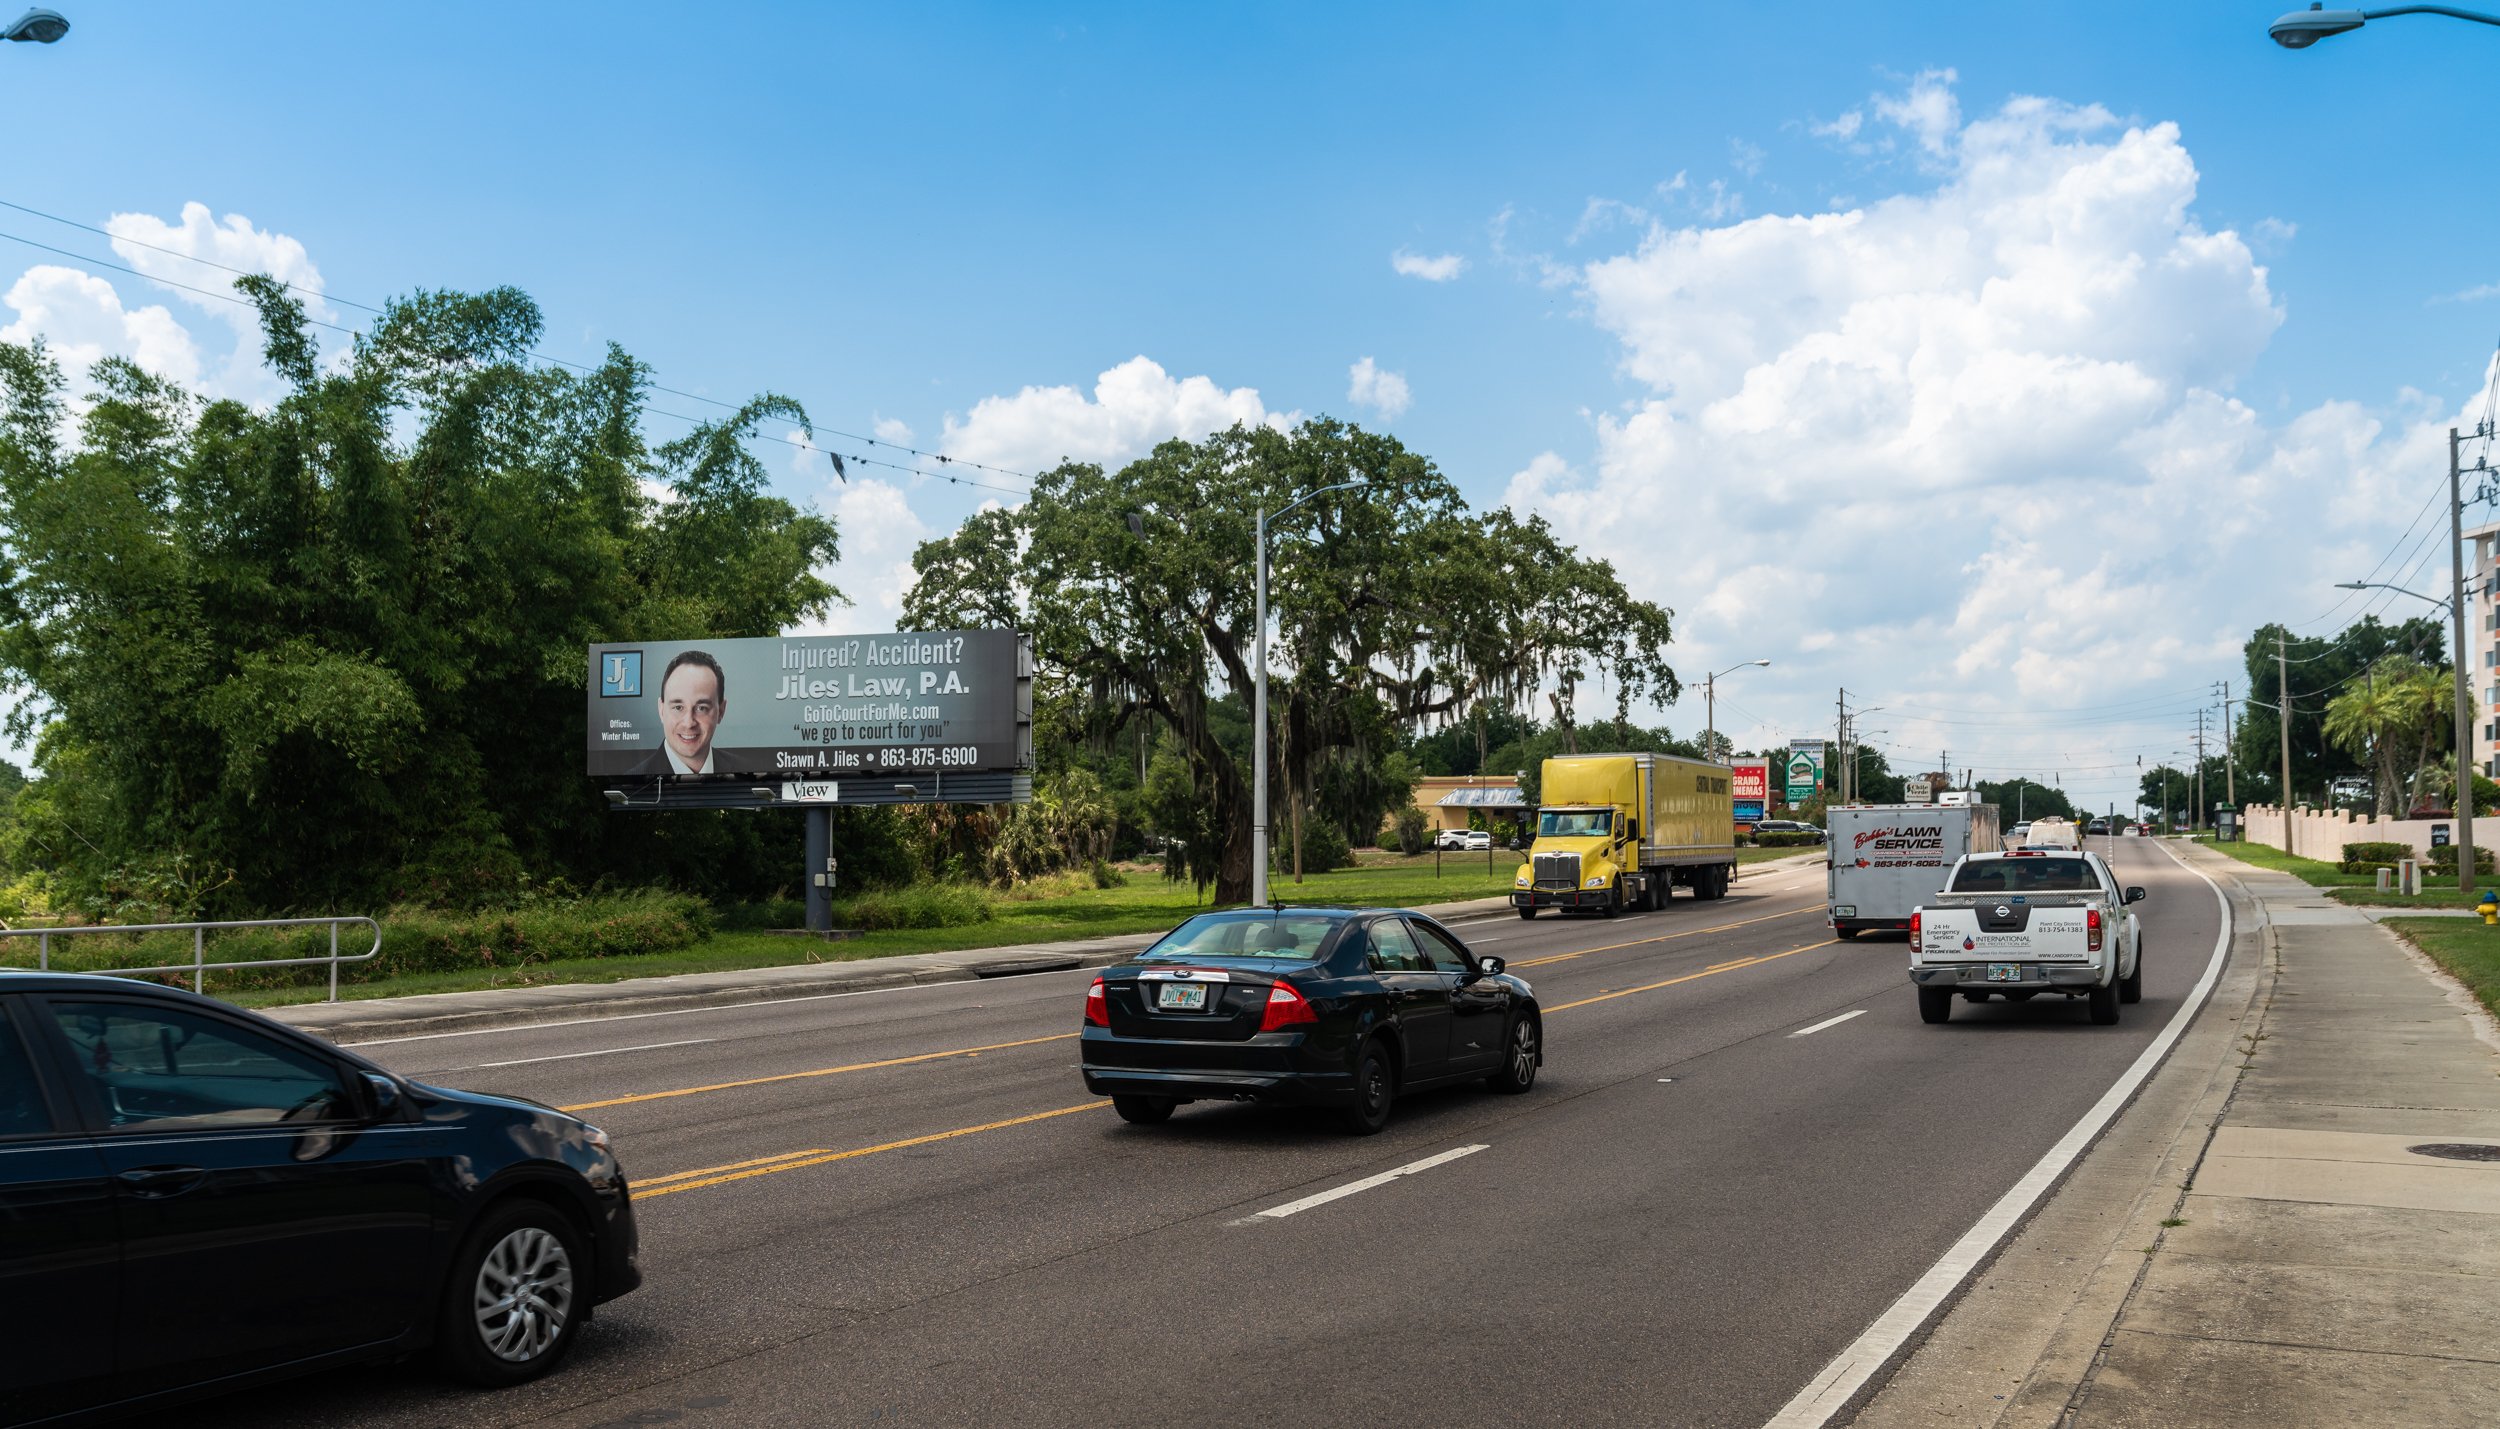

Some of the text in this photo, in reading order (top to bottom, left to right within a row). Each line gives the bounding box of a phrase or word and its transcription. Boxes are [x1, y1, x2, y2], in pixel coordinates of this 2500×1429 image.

[782, 637, 964, 673] Injured? Accident?
[775, 671, 970, 700] Jiles Law, P.A.
[804, 703, 939, 723] GoToCourtForMe.com
[609, 719, 632, 729] Offices:
[601, 731, 640, 741] Winter Haven
[823, 728, 837, 744] go
[841, 724, 854, 740] to
[859, 723, 893, 740] court
[898, 722, 915, 739] for
[776, 746, 978, 768] Shawn A. Jiles 863-875-6900
[1733, 776, 1760, 785] GRAND
[791, 783, 829, 798] View
[1733, 786, 1763, 796] INEMAS
[1894, 826, 1942, 837] LAWN
[1874, 838, 1942, 849] SERVICE
